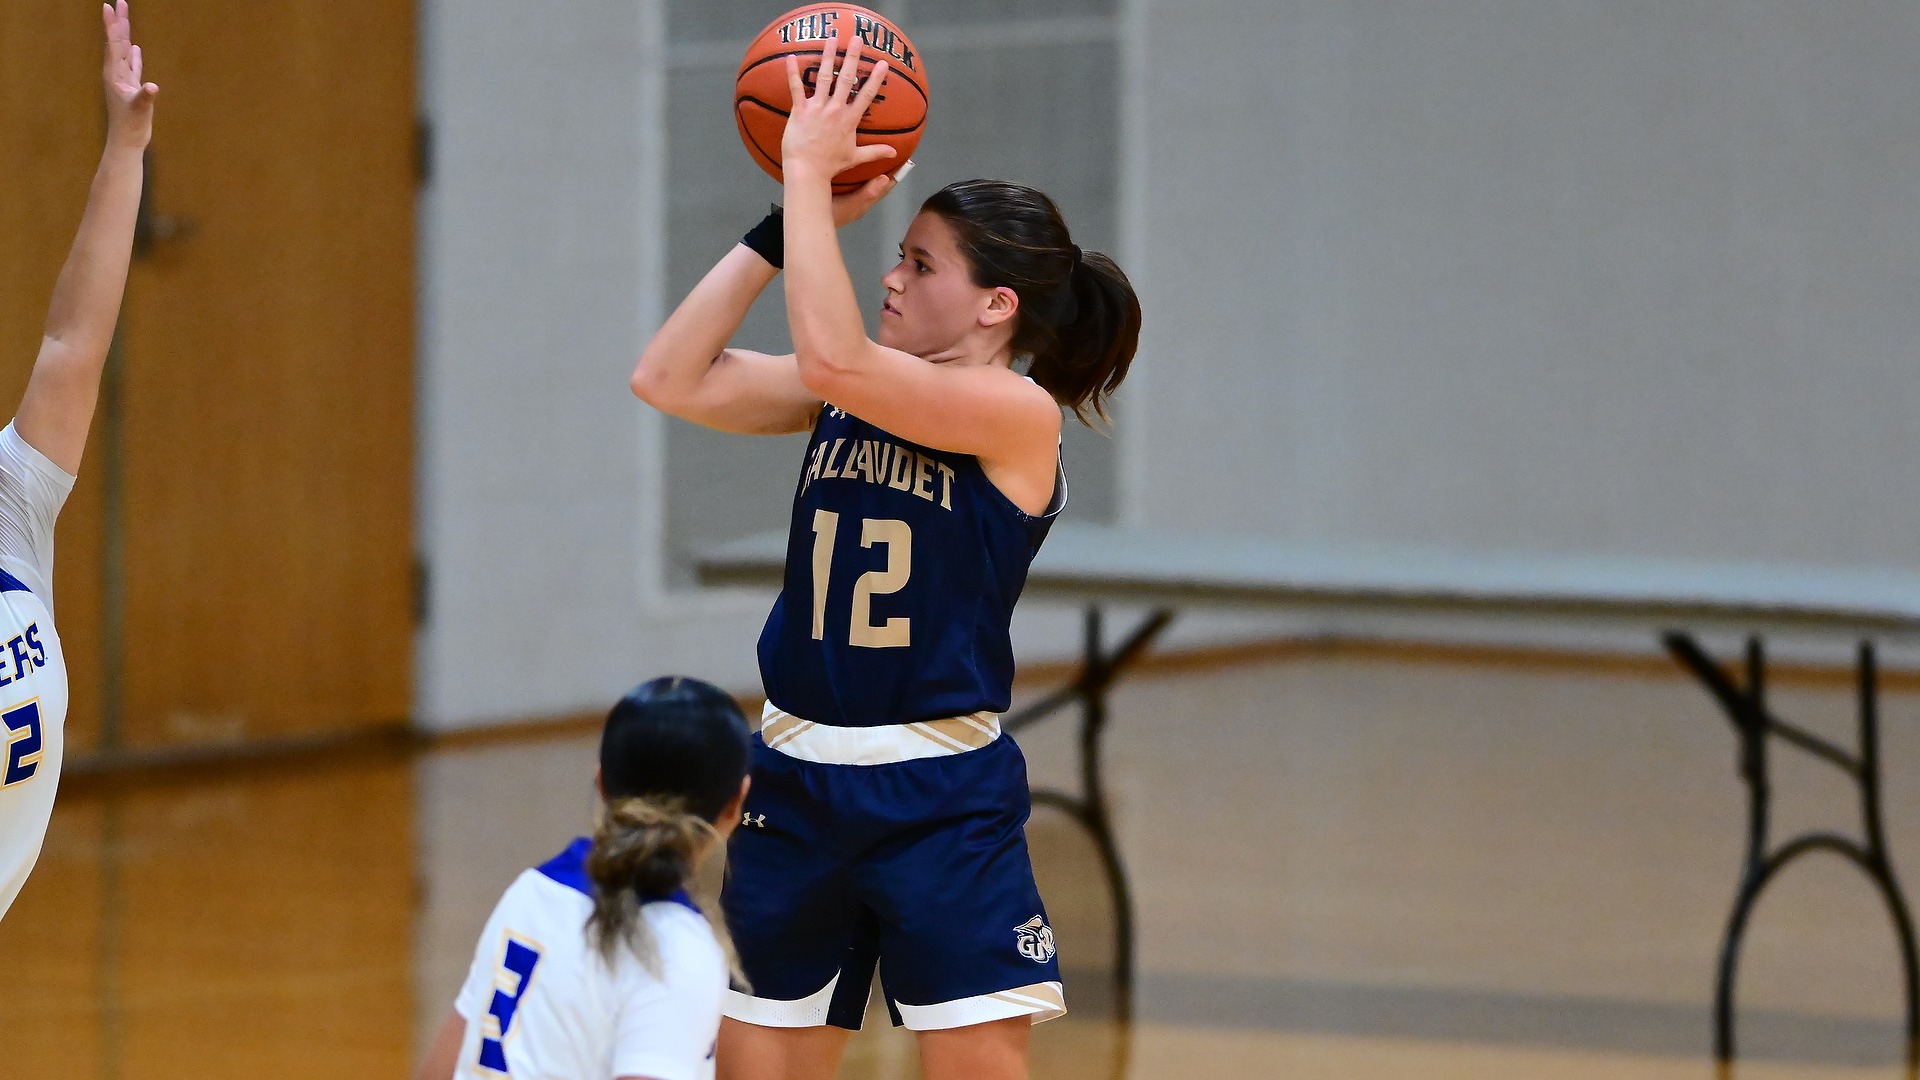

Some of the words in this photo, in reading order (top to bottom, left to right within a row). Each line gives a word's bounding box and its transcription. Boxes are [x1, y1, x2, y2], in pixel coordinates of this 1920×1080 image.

[778, 11, 839, 44] THE
[853, 13, 916, 73] ROCK
[801, 438, 955, 511] ALLAUDET
[812, 508, 912, 648] 12
[0, 697, 44, 790] 2
[475, 930, 544, 1079] 3
